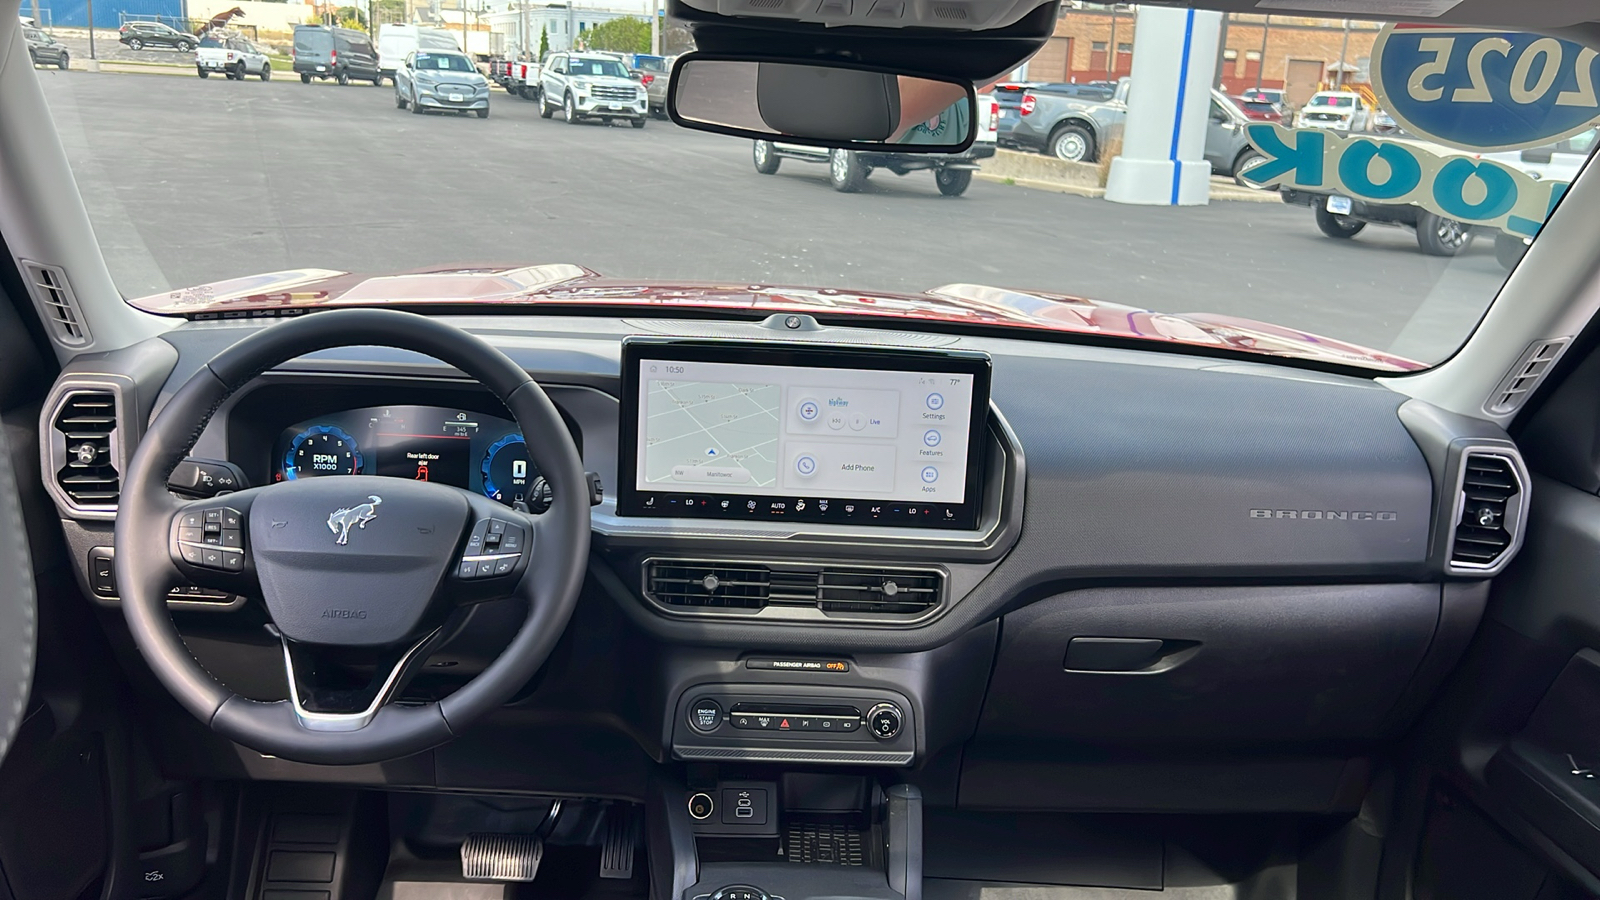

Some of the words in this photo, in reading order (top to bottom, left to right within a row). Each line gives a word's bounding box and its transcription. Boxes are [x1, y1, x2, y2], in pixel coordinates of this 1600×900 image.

[665, 365, 685, 374] 10:50
[922, 412, 946, 421] Settings
[869, 418, 881, 426] Live
[919, 449, 944, 457] Features
[313, 454, 338, 464] RPM
[313, 463, 337, 471] X1000
[512, 460, 527, 479] 0
[841, 464, 854, 472] Add
[855, 464, 875, 472] Phone
[513, 478, 526, 486] MPH
[1250, 509, 1397, 521] BRONCO
[321, 608, 367, 619] AIRBAG
